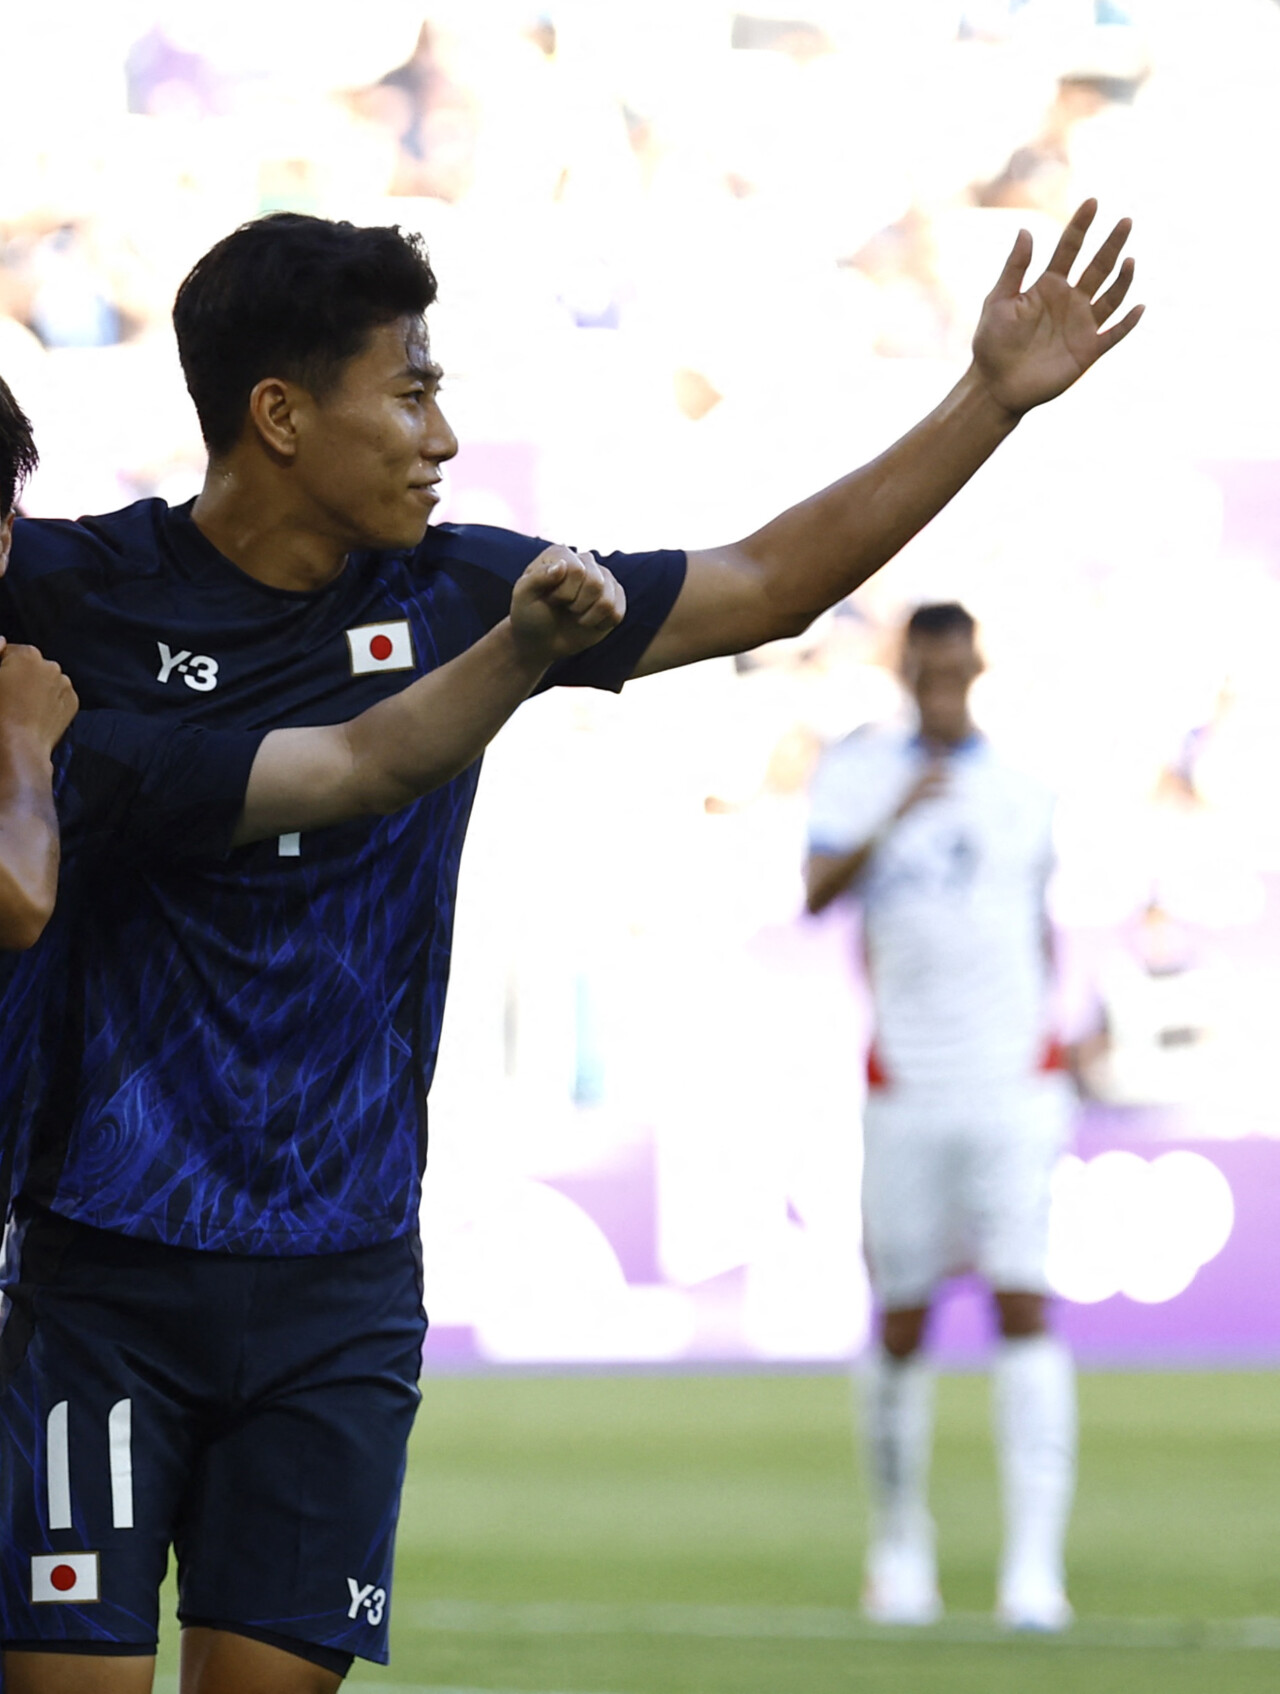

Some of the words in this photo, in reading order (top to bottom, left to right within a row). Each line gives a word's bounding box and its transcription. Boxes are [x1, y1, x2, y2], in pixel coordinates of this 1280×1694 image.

[156, 641, 219, 692] Y-3
[47, 1398, 134, 1530] 11
[347, 1577, 386, 1626] Y-3
